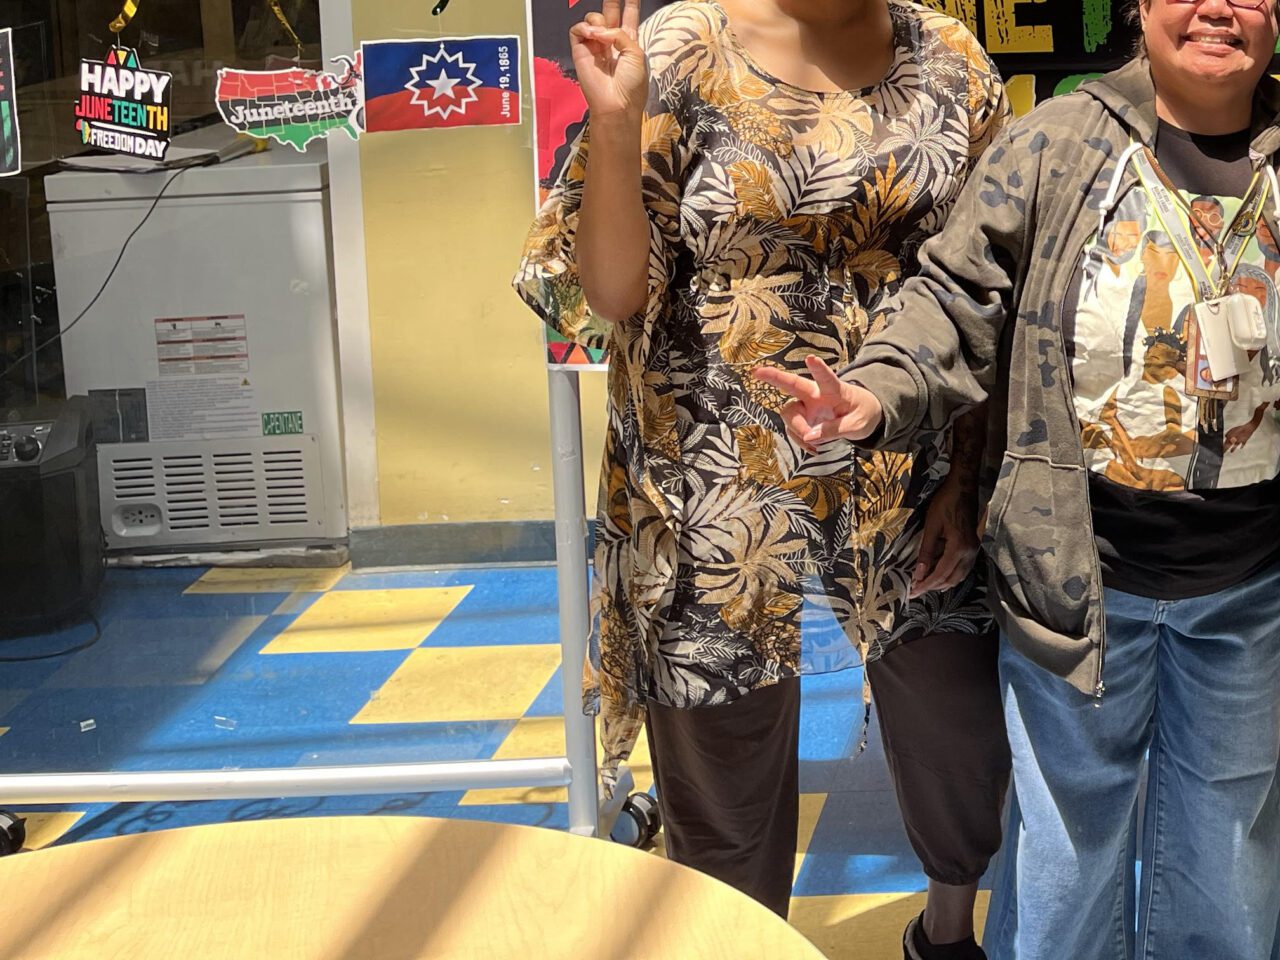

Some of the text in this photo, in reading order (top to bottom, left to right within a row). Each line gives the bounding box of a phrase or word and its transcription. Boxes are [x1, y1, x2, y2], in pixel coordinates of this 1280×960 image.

[80, 62, 170, 103] HAPPY
[498, 46, 511, 118] June 19, 1865
[75, 95, 168, 131] JUNETEENTH
[230, 95, 354, 124] Juneteenth
[91, 128, 167, 158] FREEDOM DAY
[262, 412, 303, 434] C-PENTANE
